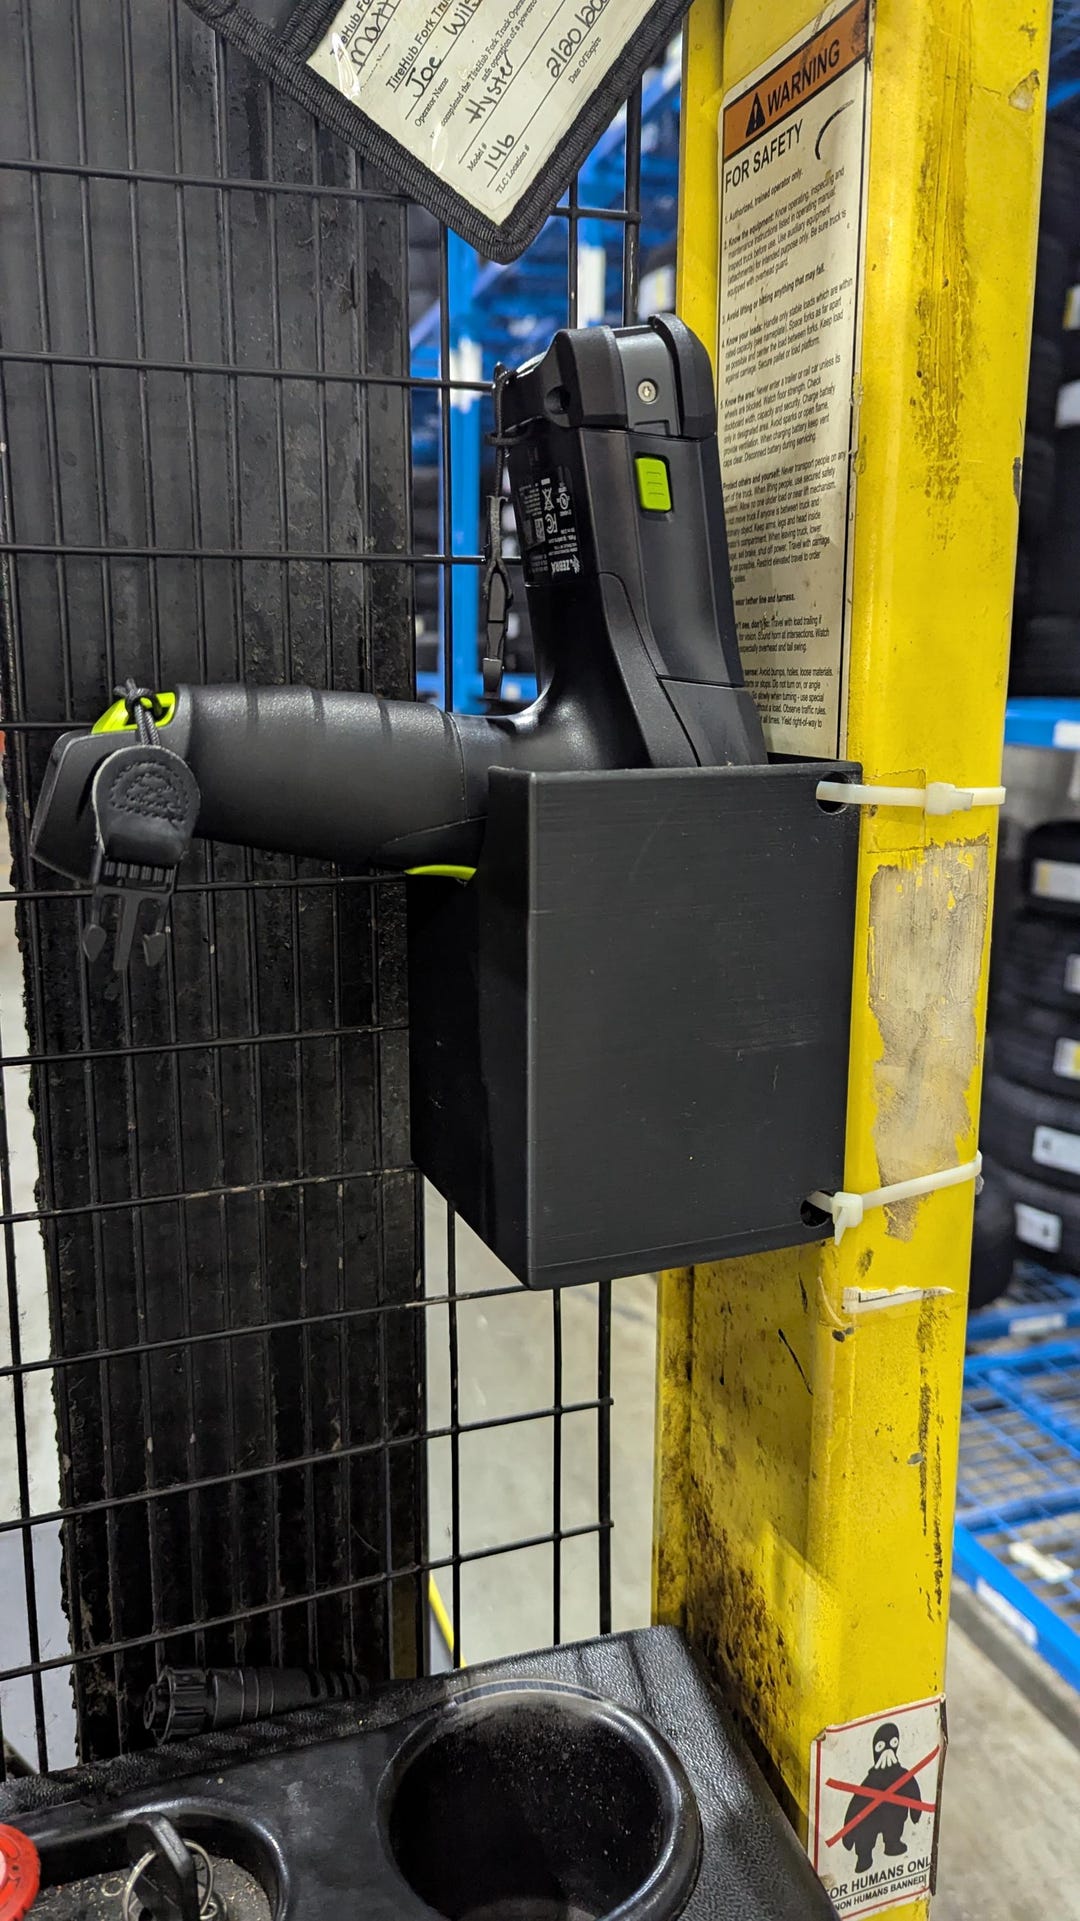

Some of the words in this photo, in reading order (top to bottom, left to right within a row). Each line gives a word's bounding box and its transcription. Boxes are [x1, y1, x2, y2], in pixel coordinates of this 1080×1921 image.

[386, 46, 419, 90] TireHub
[414, 16, 437, 45] Fork
[439, 92, 464, 126] completed
[460, 81, 471, 92] the
[467, 53, 488, 81] TireHub
[485, 37, 499, 54] Fork
[495, 18, 511, 37] Truck
[480, 67, 492, 81] safe
[489, 37, 512, 68] operation
[508, 29, 517, 38] of
[568, 67, 581, 83] Date
[578, 56, 587, 67] Of
[584, 36, 602, 58] Expire
[405, 56, 442, 99] Joe
[464, 53, 517, 124] Hyster
[768, 39, 840, 116] WARNING
[414, 96, 436, 127] Operator
[433, 77, 448, 97] Name
[467, 148, 484, 171] Model
[483, 134, 516, 171] 146
[496, 178, 508, 193] TLC
[505, 150, 526, 178] Location
[725, 159, 750, 194] FOR
[753, 120, 804, 175] SAFETY
[551, 559, 571, 575] ZEBRA
[827, 1884, 848, 1899] OR
[851, 1864, 904, 1892] HUMANS
[907, 1856, 931, 1873] ONL
[853, 1887, 889, 1905] HUMANS
